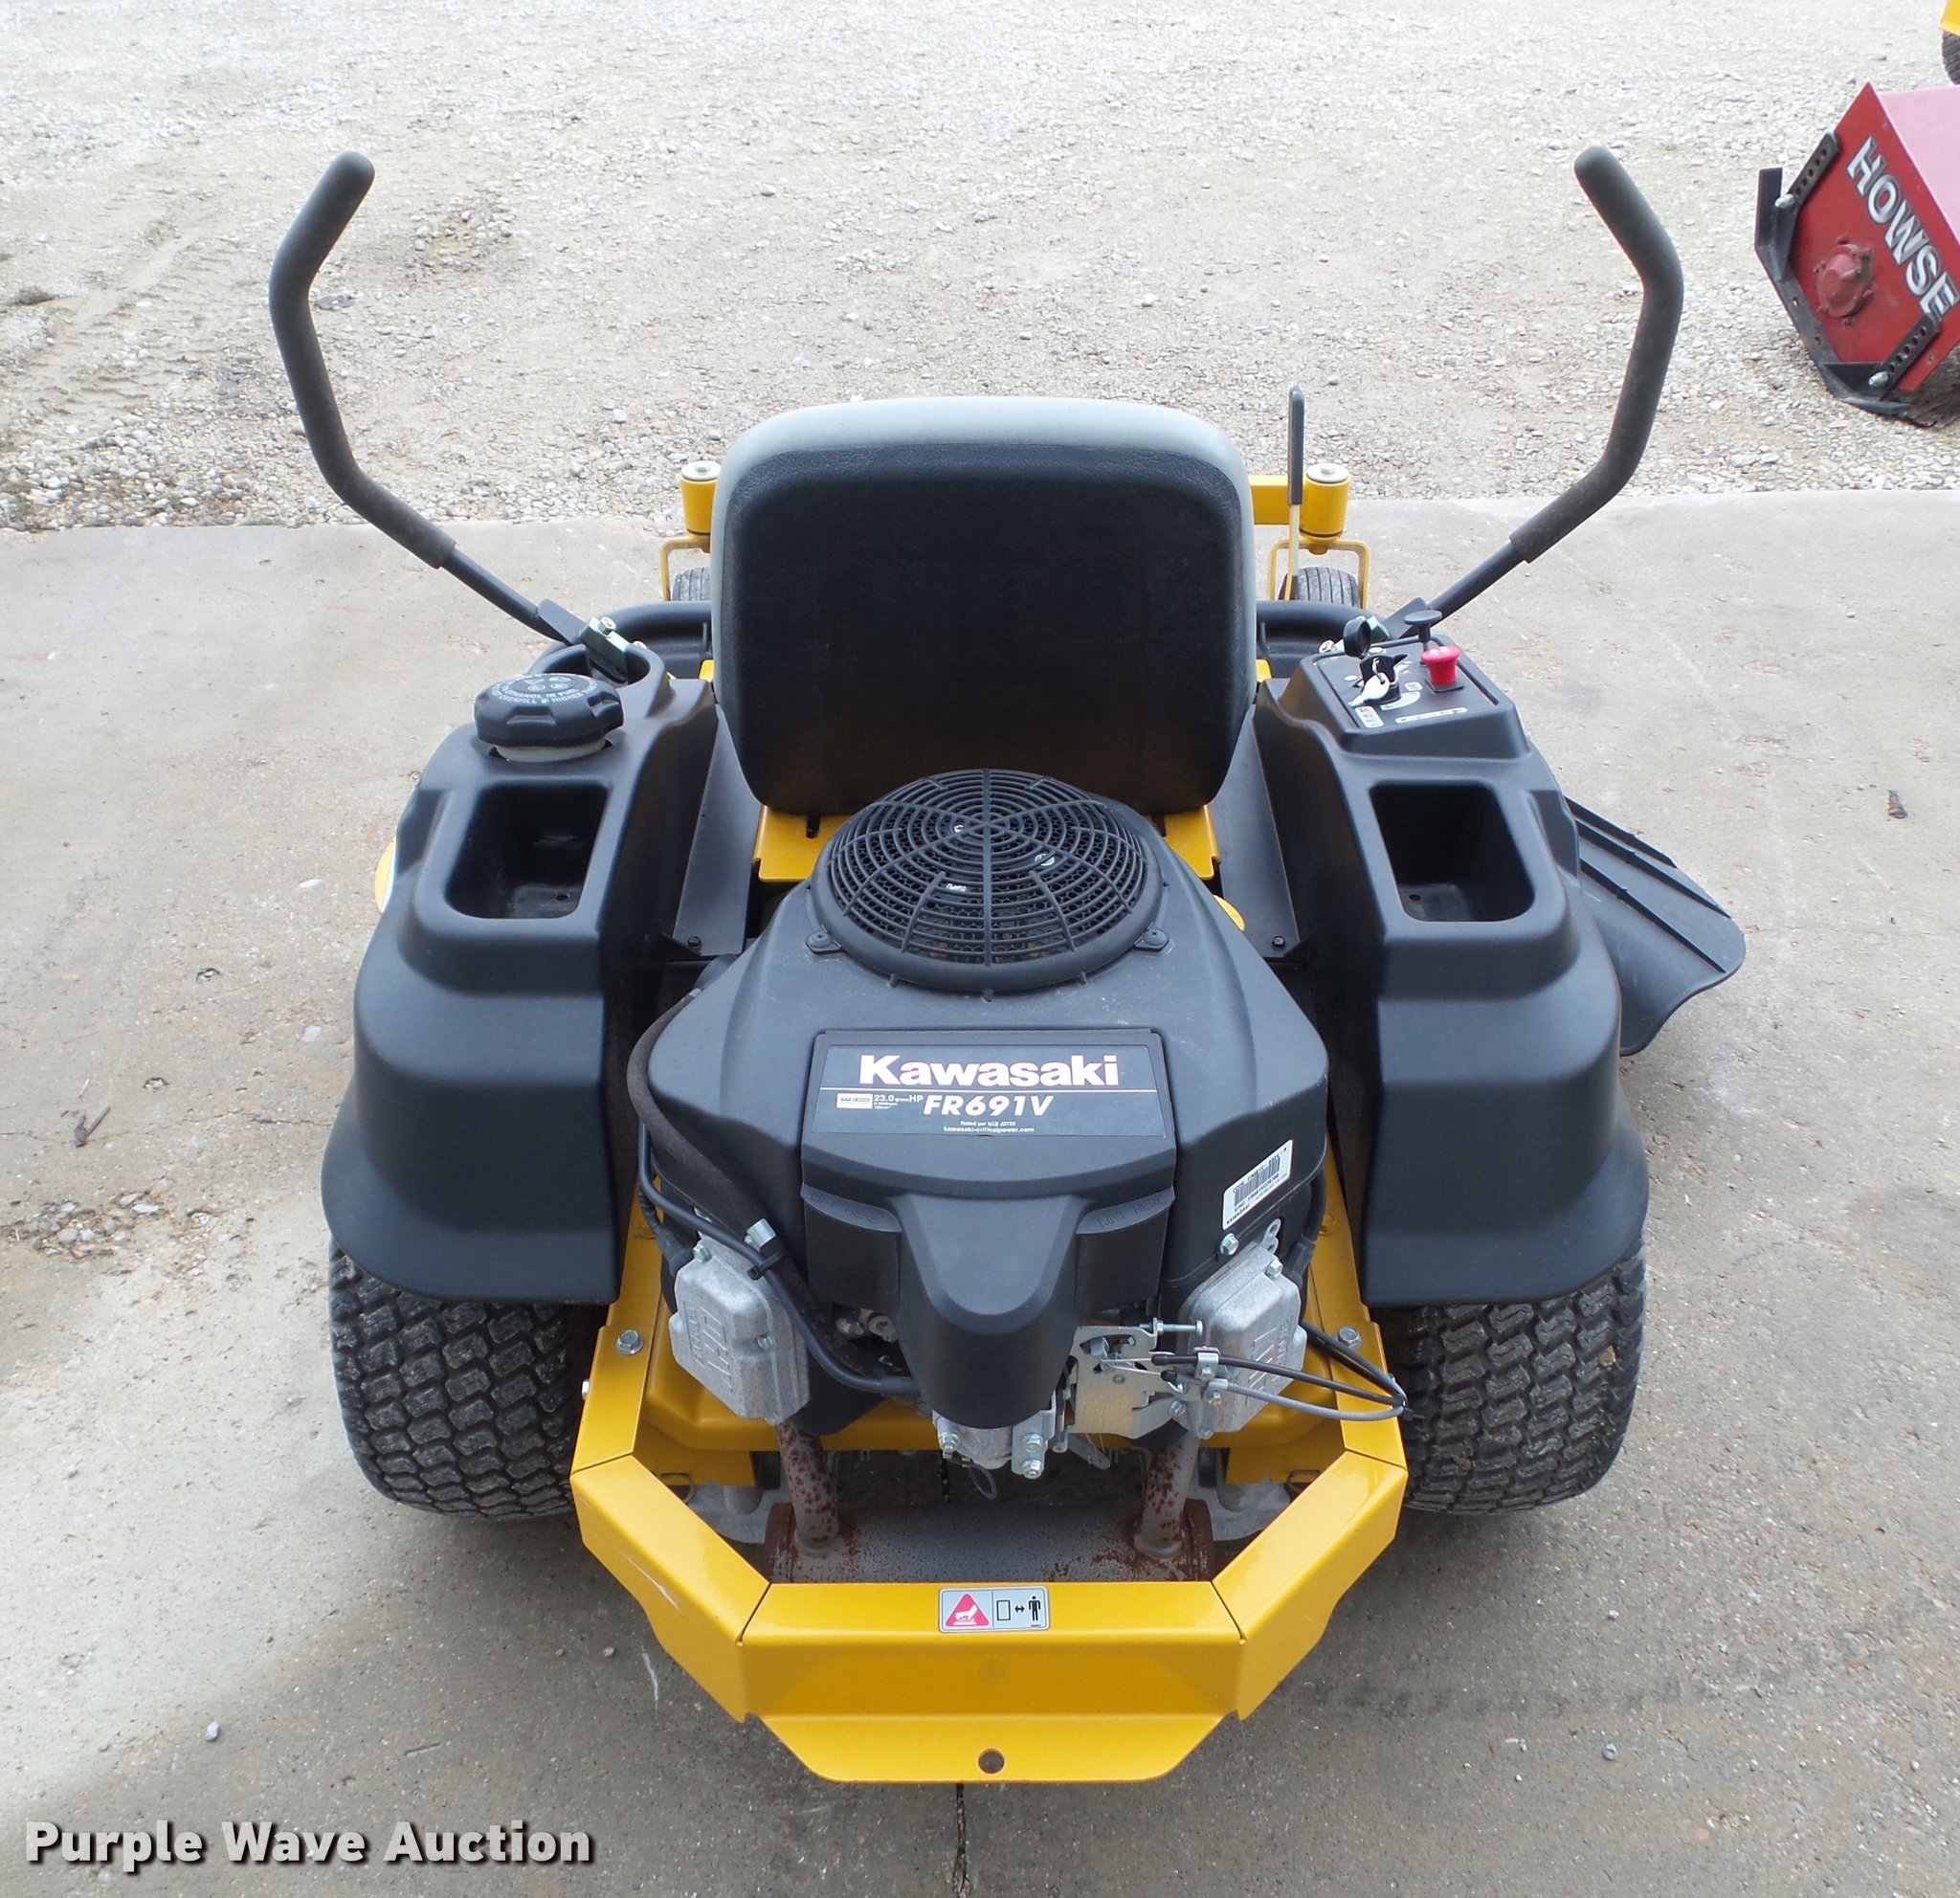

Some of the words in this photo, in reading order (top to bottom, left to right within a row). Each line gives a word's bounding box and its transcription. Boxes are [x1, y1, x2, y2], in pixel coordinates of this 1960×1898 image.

[1846, 135, 1960, 322] HOWSE
[859, 1054, 1119, 1087] Kawasaki
[923, 1094, 1054, 1116] FR691V
